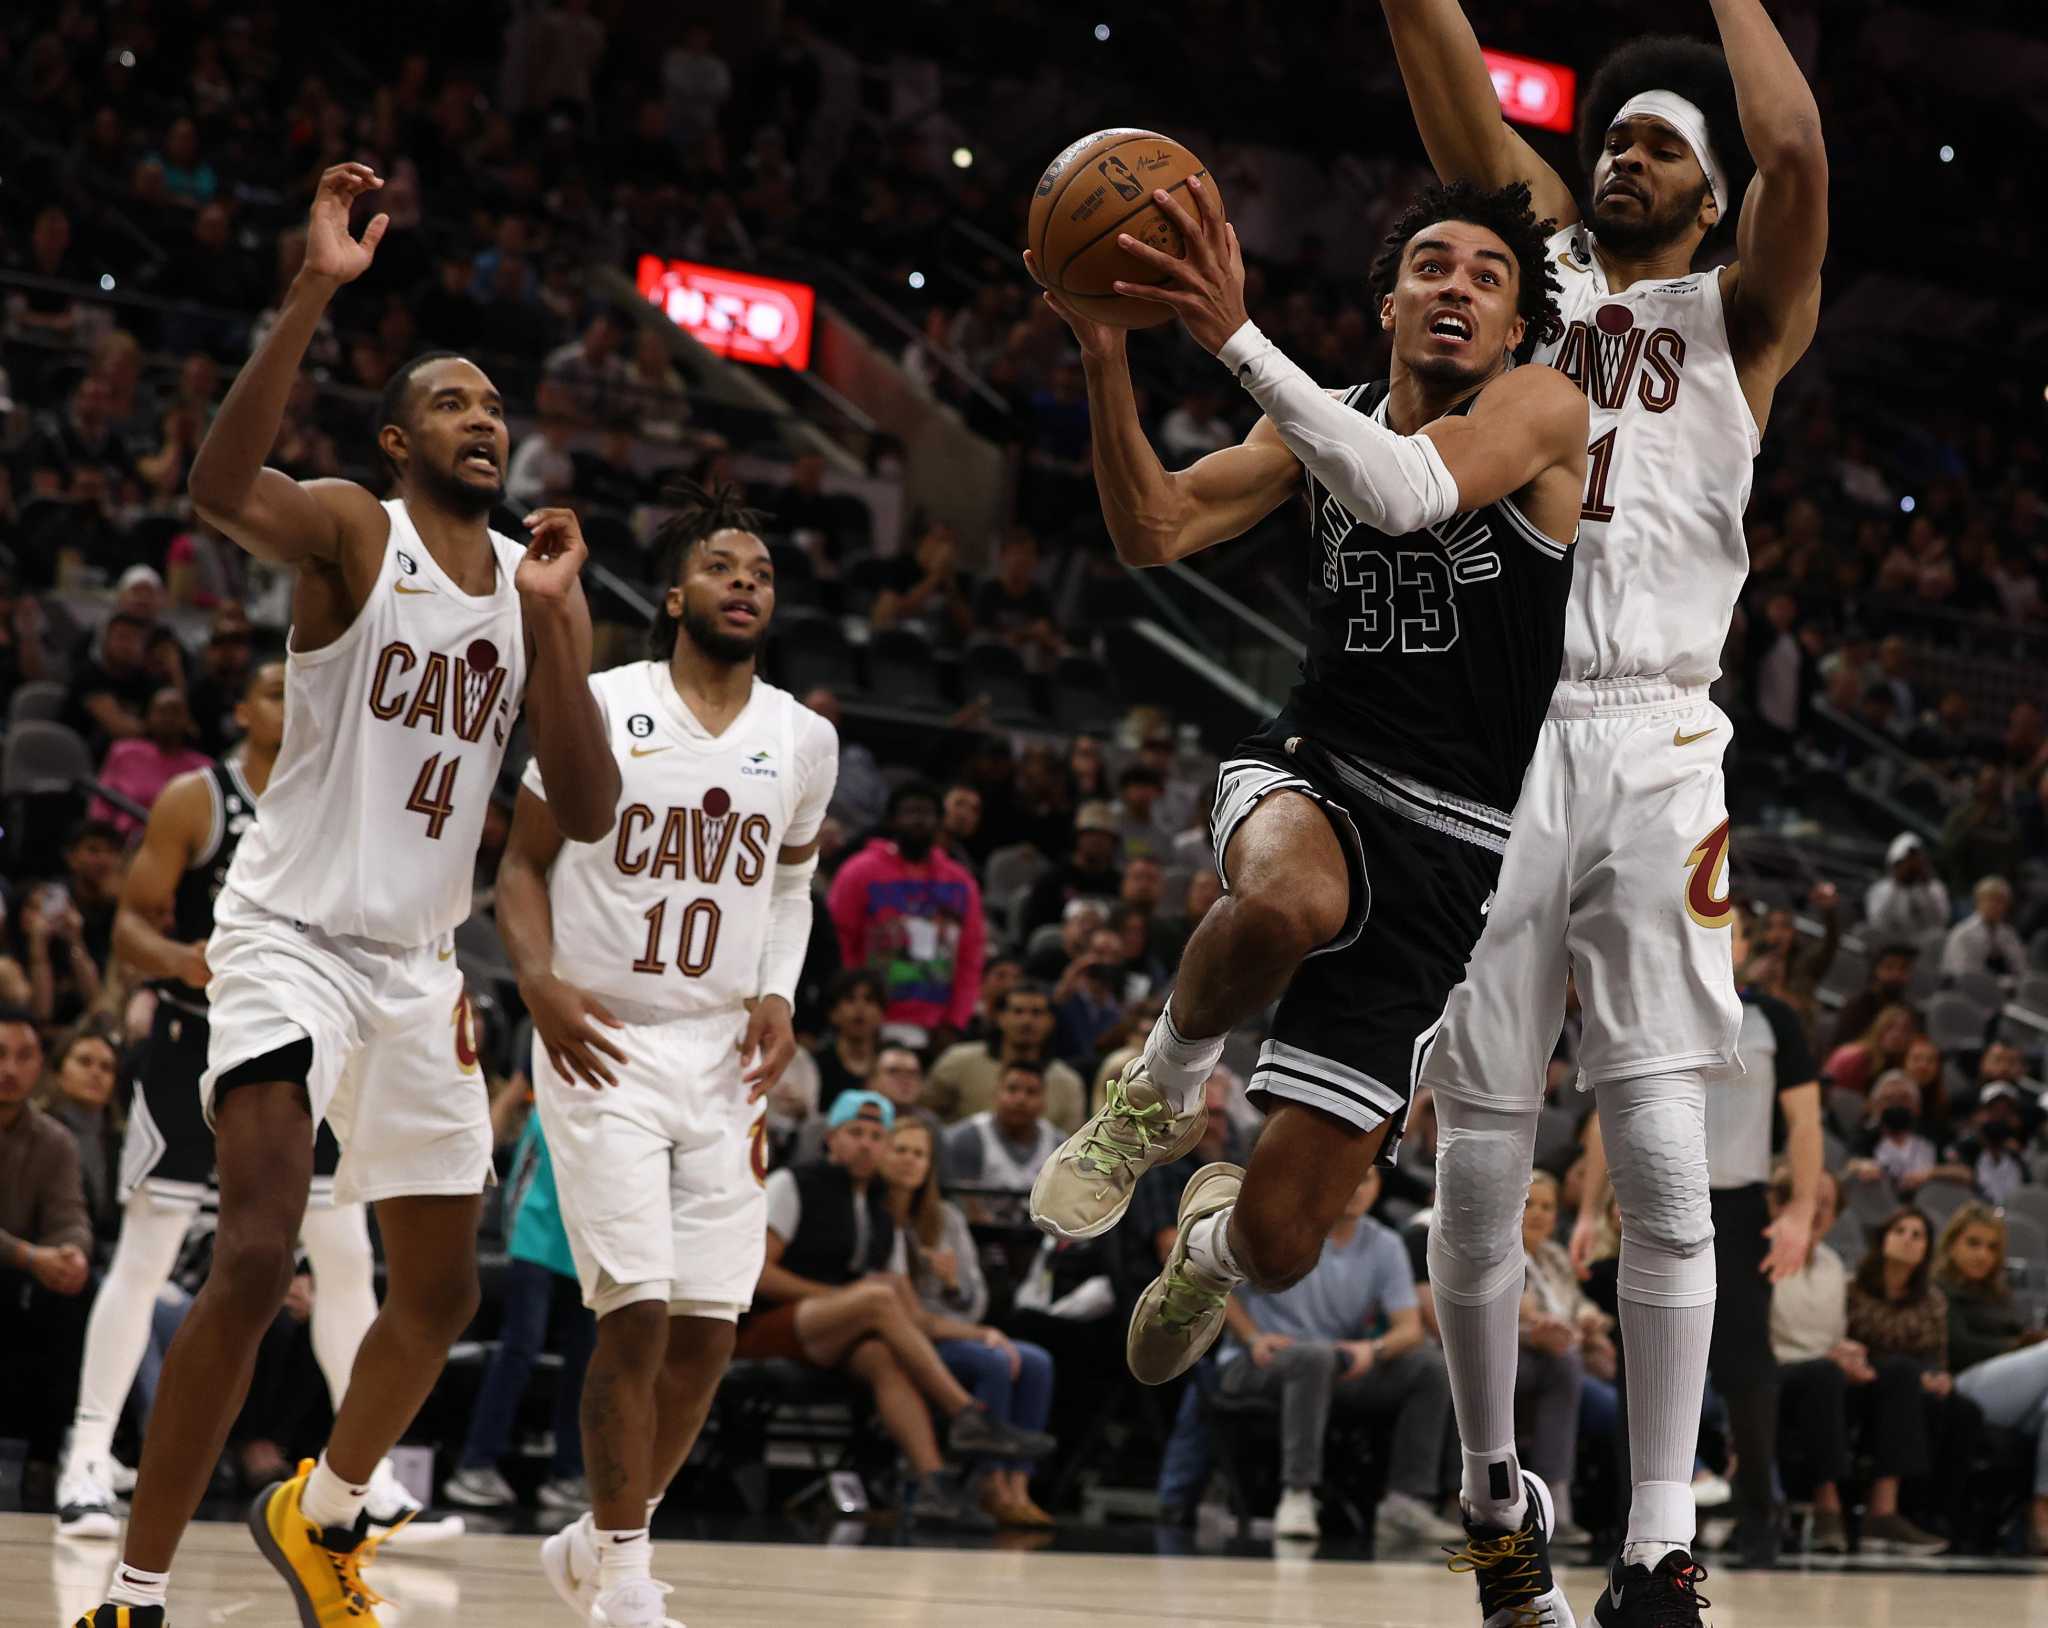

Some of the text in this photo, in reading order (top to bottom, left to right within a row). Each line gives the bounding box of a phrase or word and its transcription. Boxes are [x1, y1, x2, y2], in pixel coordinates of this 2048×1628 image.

[1546, 315, 1687, 414] AVS
[1340, 550, 1460, 653] 33
[631, 716, 651, 736] 6
[405, 751, 461, 840] 4
[614, 802, 771, 887] CAVS
[632, 897, 722, 979] 10
